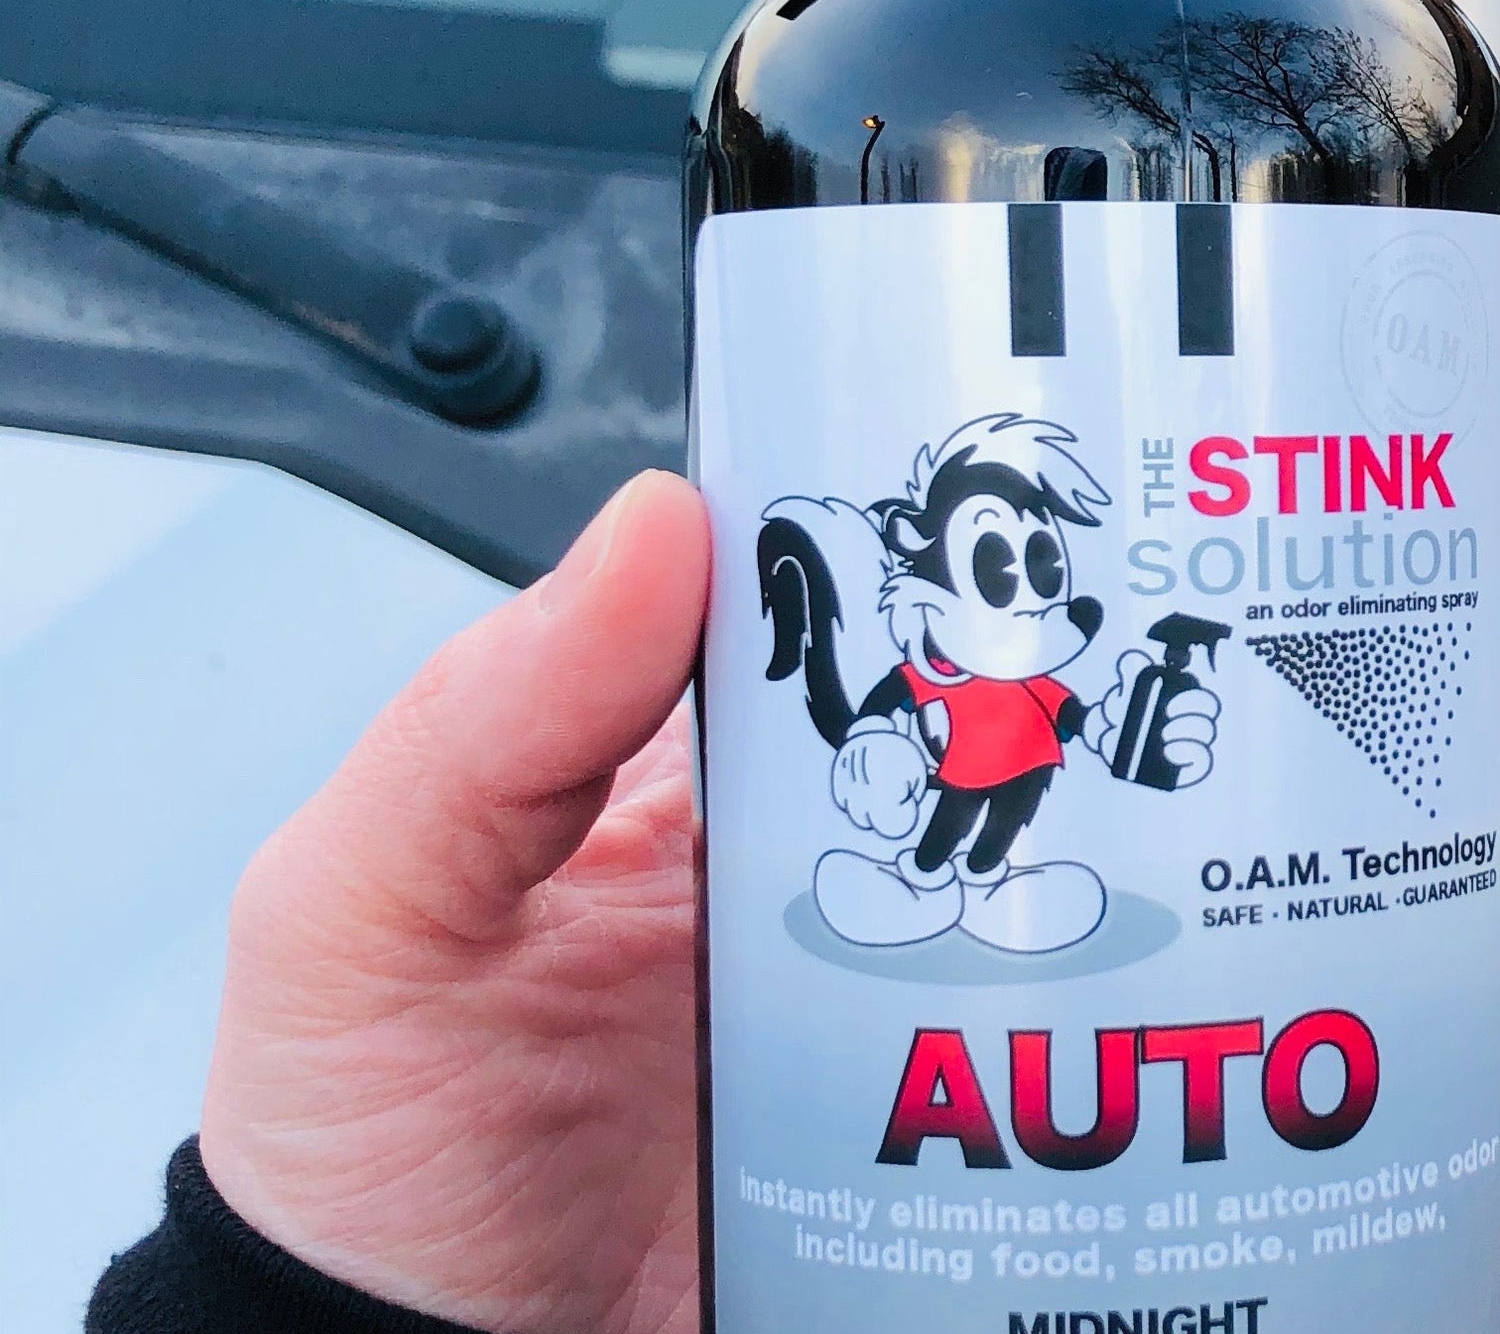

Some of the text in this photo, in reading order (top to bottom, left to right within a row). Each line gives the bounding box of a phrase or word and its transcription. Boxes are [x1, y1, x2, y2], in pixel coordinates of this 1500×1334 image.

[1142, 436, 1175, 517] THE
[1187, 433, 1457, 517] STINK
[1127, 513, 1479, 597] solution
[1245, 590, 1480, 620] an odor eliminating spray
[1200, 831, 1497, 893] O.A.M. Technology
[1202, 868, 1498, 928] SAFE NATURAL GUARANTEED
[874, 1007, 1381, 1172] AUTO
[739, 1134, 1500, 1234] instantly eliminates all automotive odor
[795, 1201, 1446, 1283] including food, smoke, mildew,
